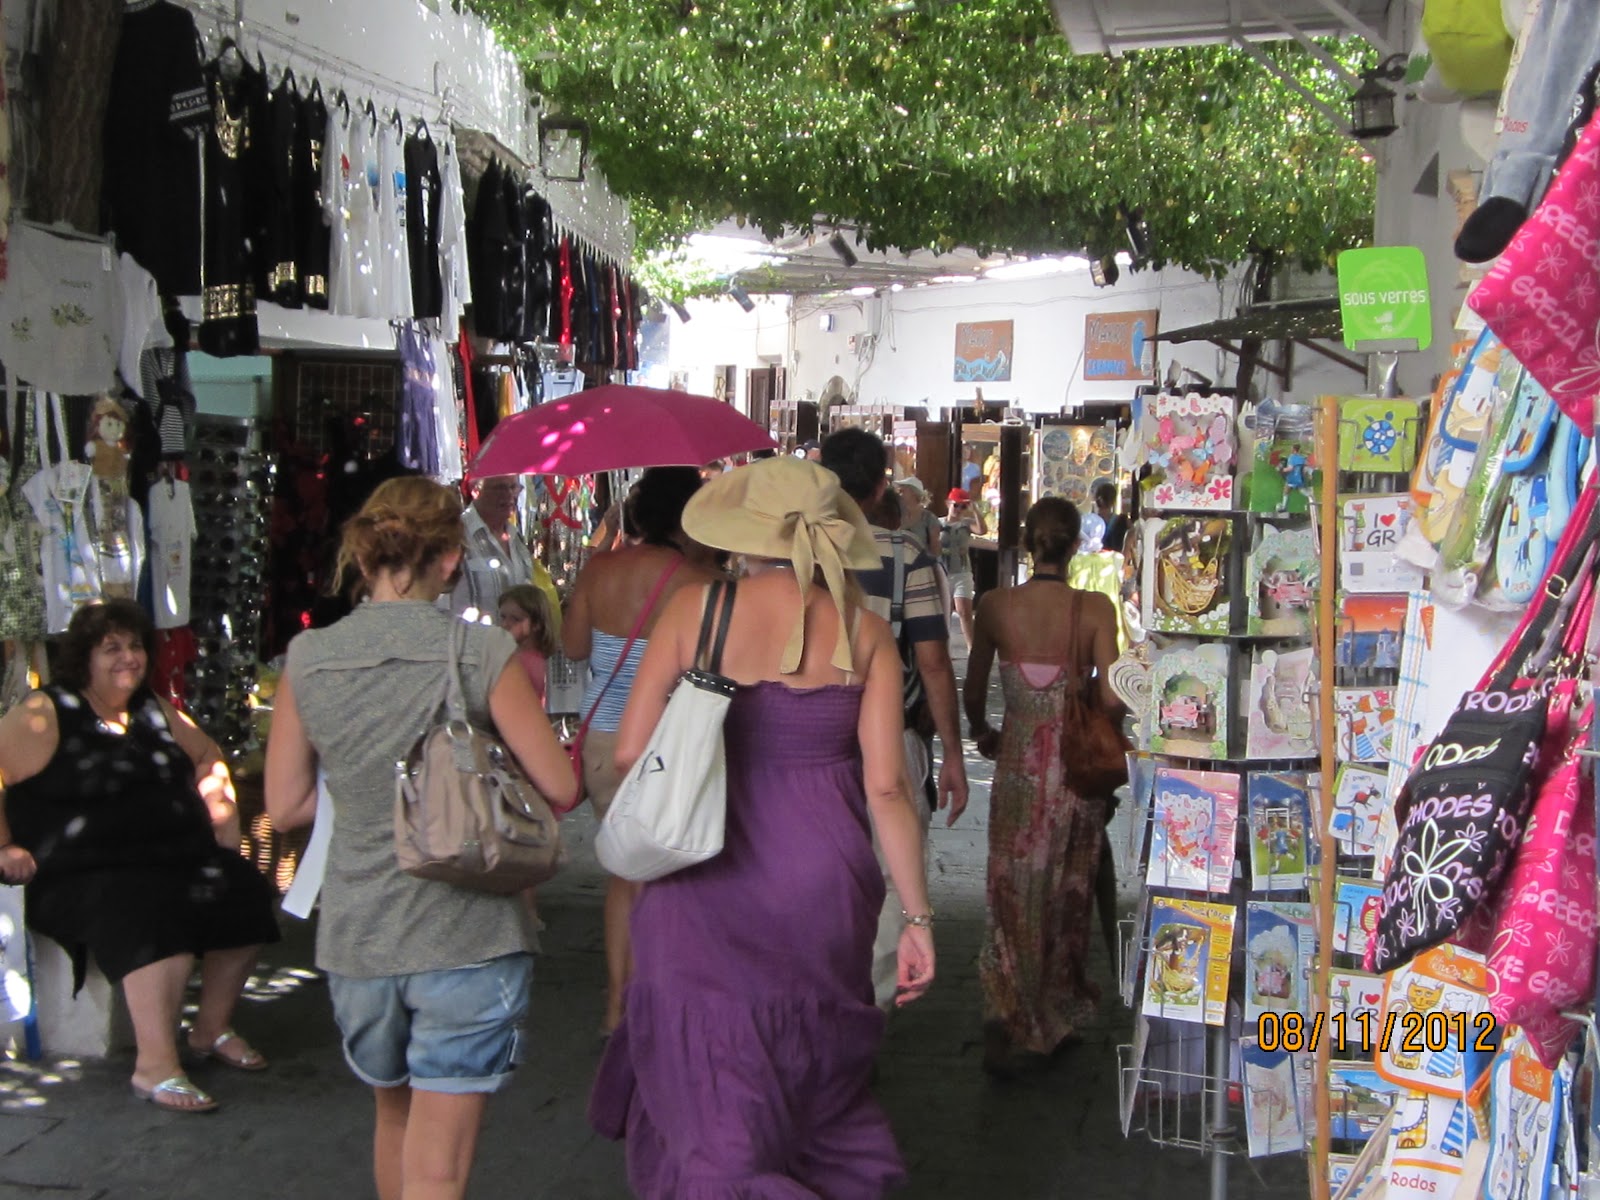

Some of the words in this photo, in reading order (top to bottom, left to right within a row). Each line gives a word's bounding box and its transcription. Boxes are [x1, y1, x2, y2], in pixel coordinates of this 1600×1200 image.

[1343, 291, 1376, 306] sous
[1379, 289, 1427, 304] verres
[1511, 274, 1585, 351] GRECIA
[1390, 1171, 1437, 1193] Rodos
